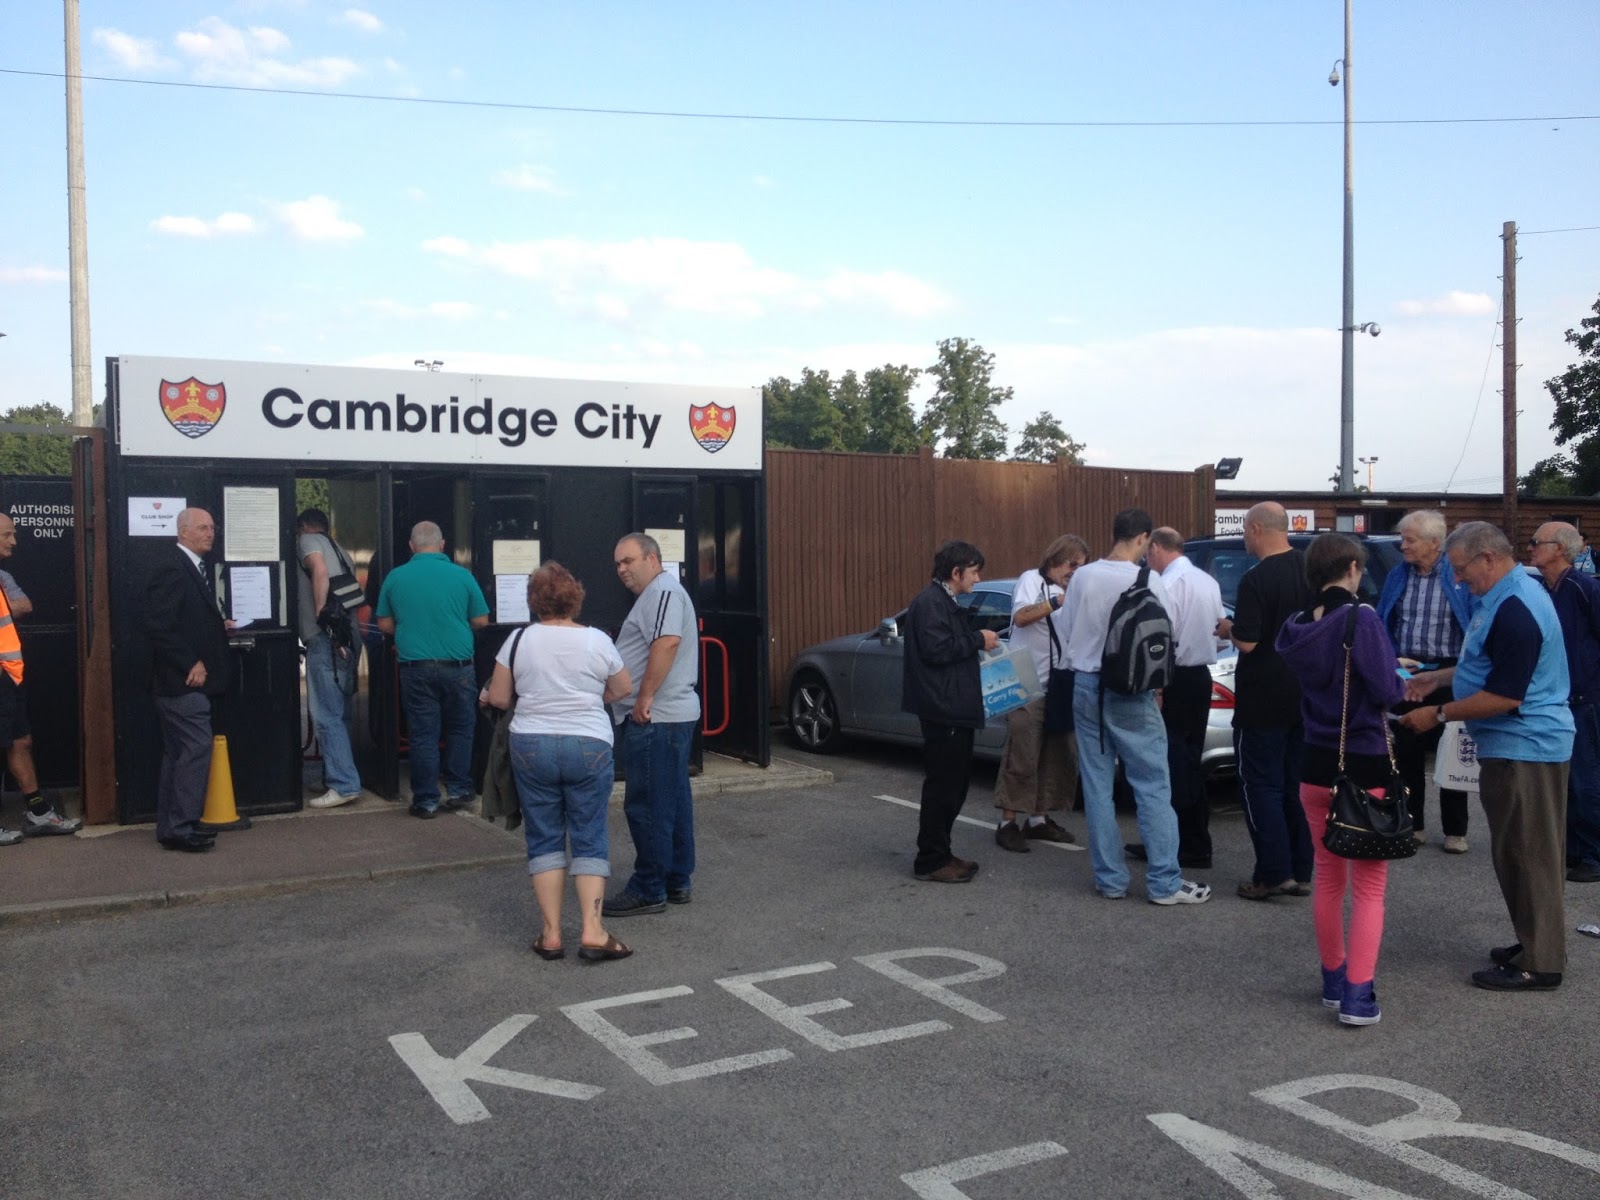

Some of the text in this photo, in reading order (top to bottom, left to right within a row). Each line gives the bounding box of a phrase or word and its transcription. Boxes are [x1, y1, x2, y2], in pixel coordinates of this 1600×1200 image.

[262, 387, 662, 449] Cambridge City
[33, 528, 64, 538] ONLY
[388, 946, 1007, 1126] KEEP
